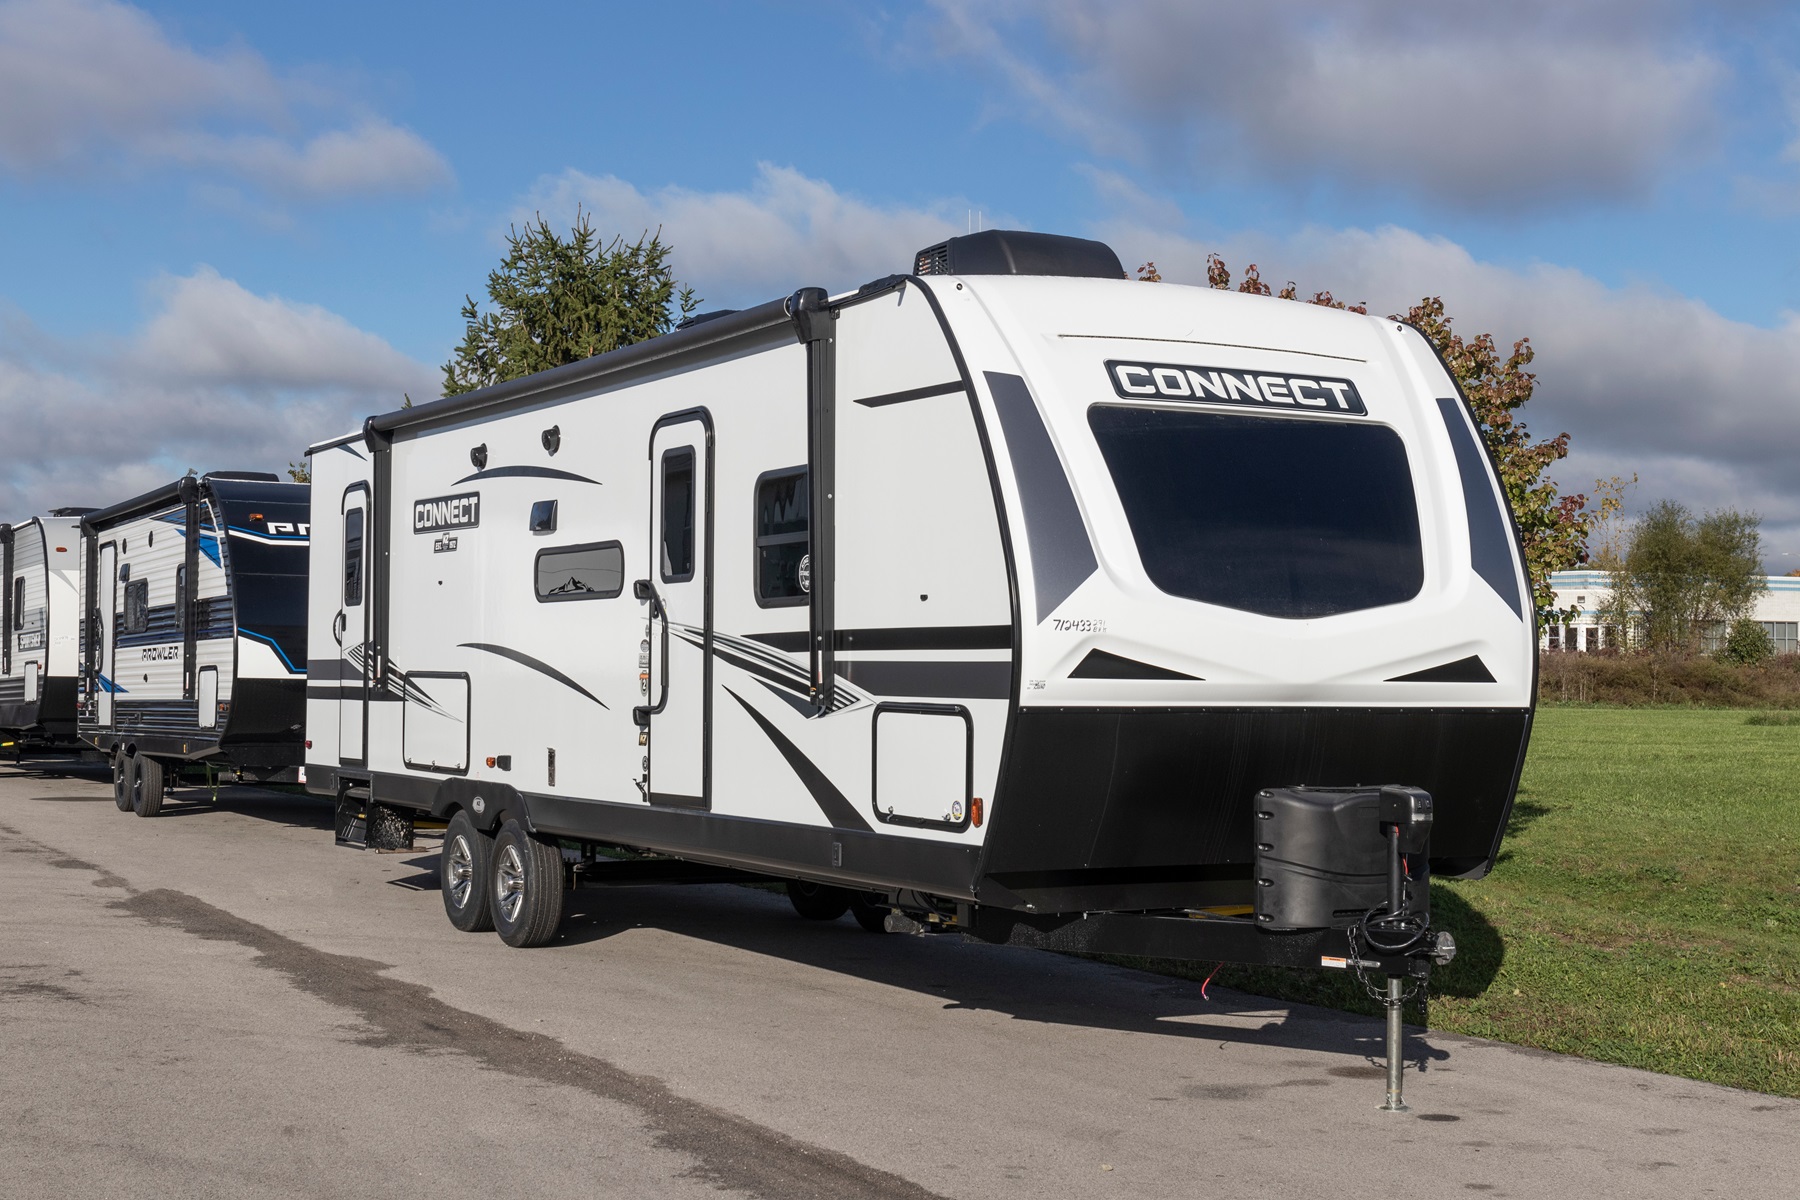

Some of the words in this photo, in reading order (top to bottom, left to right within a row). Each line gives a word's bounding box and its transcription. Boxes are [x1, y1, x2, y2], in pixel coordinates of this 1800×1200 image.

[1115, 365, 1349, 409] CONNECT
[415, 497, 478, 528] CONNECT
[1053, 619, 1092, 632] 712433
[141, 645, 179, 662] PROWLER
